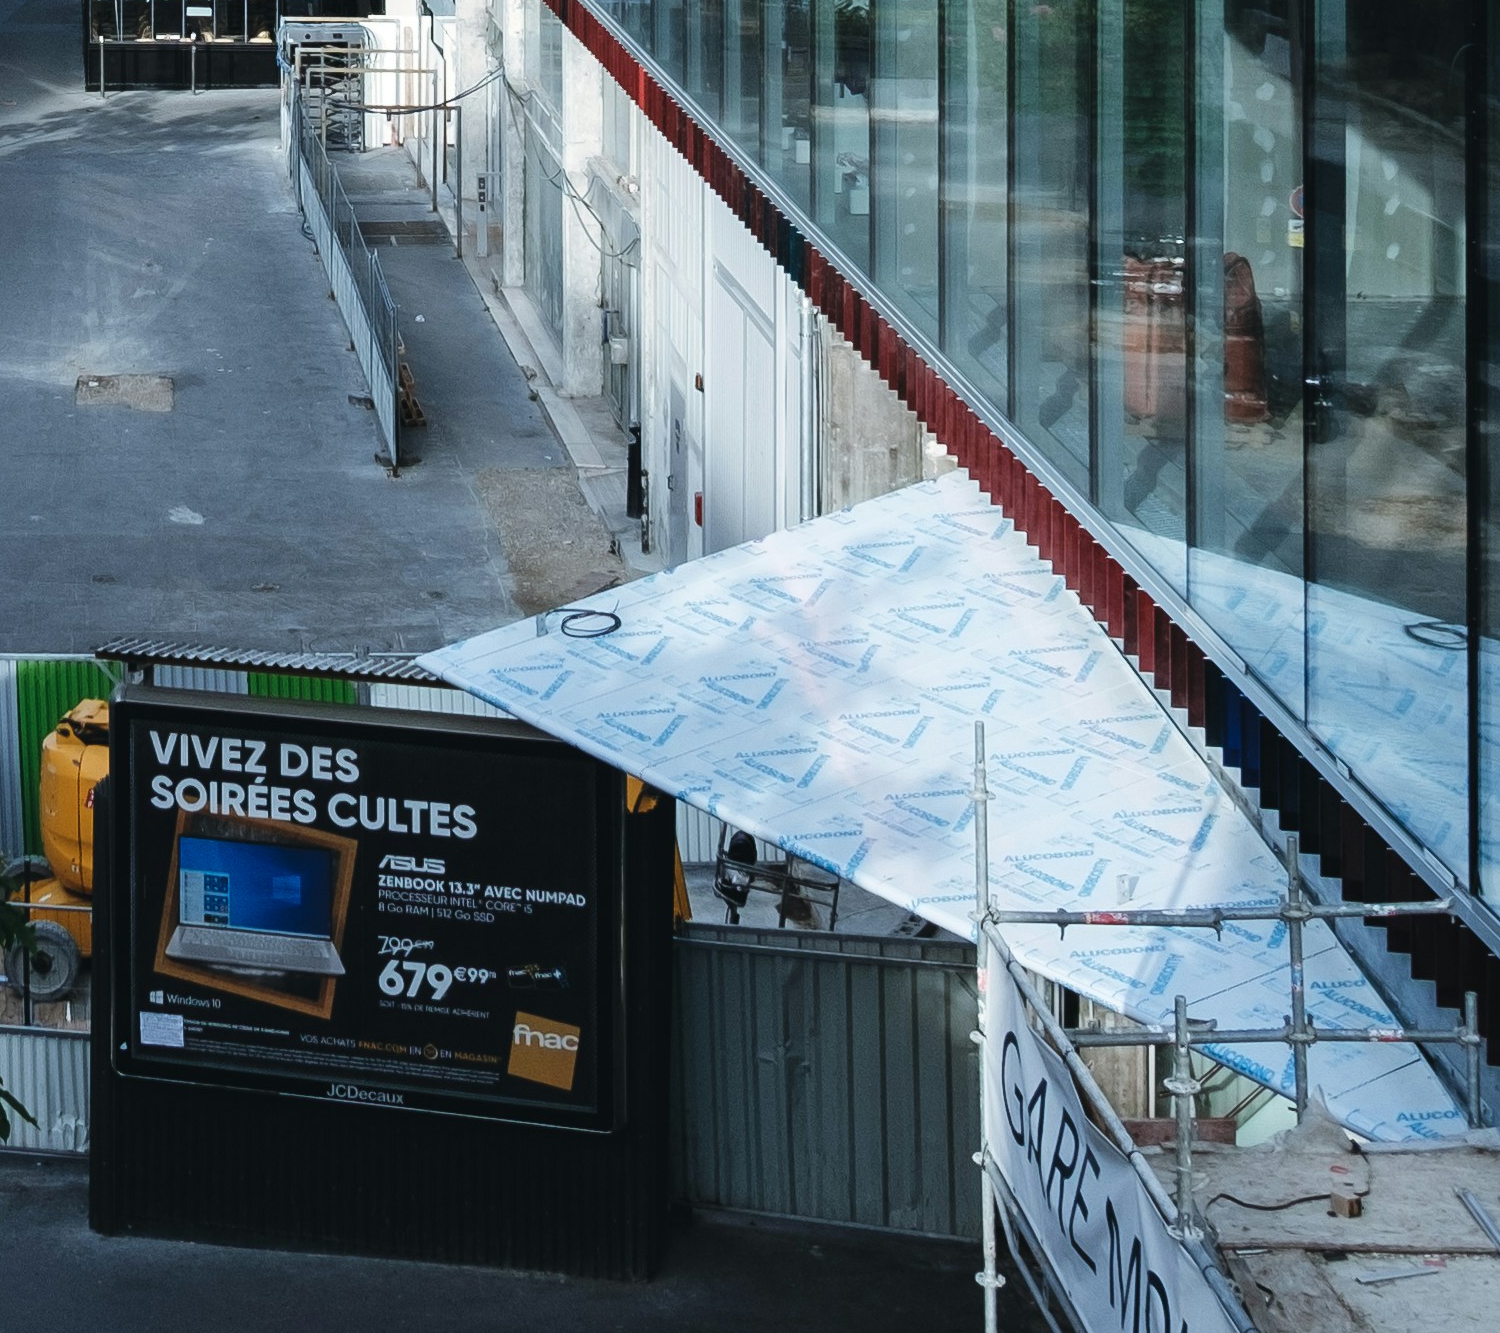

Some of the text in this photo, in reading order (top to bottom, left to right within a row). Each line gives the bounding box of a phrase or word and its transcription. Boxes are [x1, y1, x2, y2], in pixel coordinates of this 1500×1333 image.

[150, 731, 360, 783] VIVEZ DES
[151, 775, 478, 839] SOIRÉES CULTES
[378, 854, 445, 874] ASUS
[378, 874, 445, 893] ZENBOOK
[484, 885, 522, 901] AVEC
[526, 889, 586, 907] NUMPAD
[378, 889, 448, 905] PROCESSEUR
[405, 904, 429, 916] RAM
[454, 911, 471, 921] Go
[167, 993, 221, 1009] Windows 10
[300, 1034, 319, 1044] VOS
[321, 1037, 356, 1048] ACHATS
[409, 1046, 422, 1057] EN
[440, 1049, 452, 1059] EN
[513, 1023, 579, 1051] fnac
[327, 1083, 404, 1105] JCDecaux
[1001, 1030, 1100, 1276] GARE
